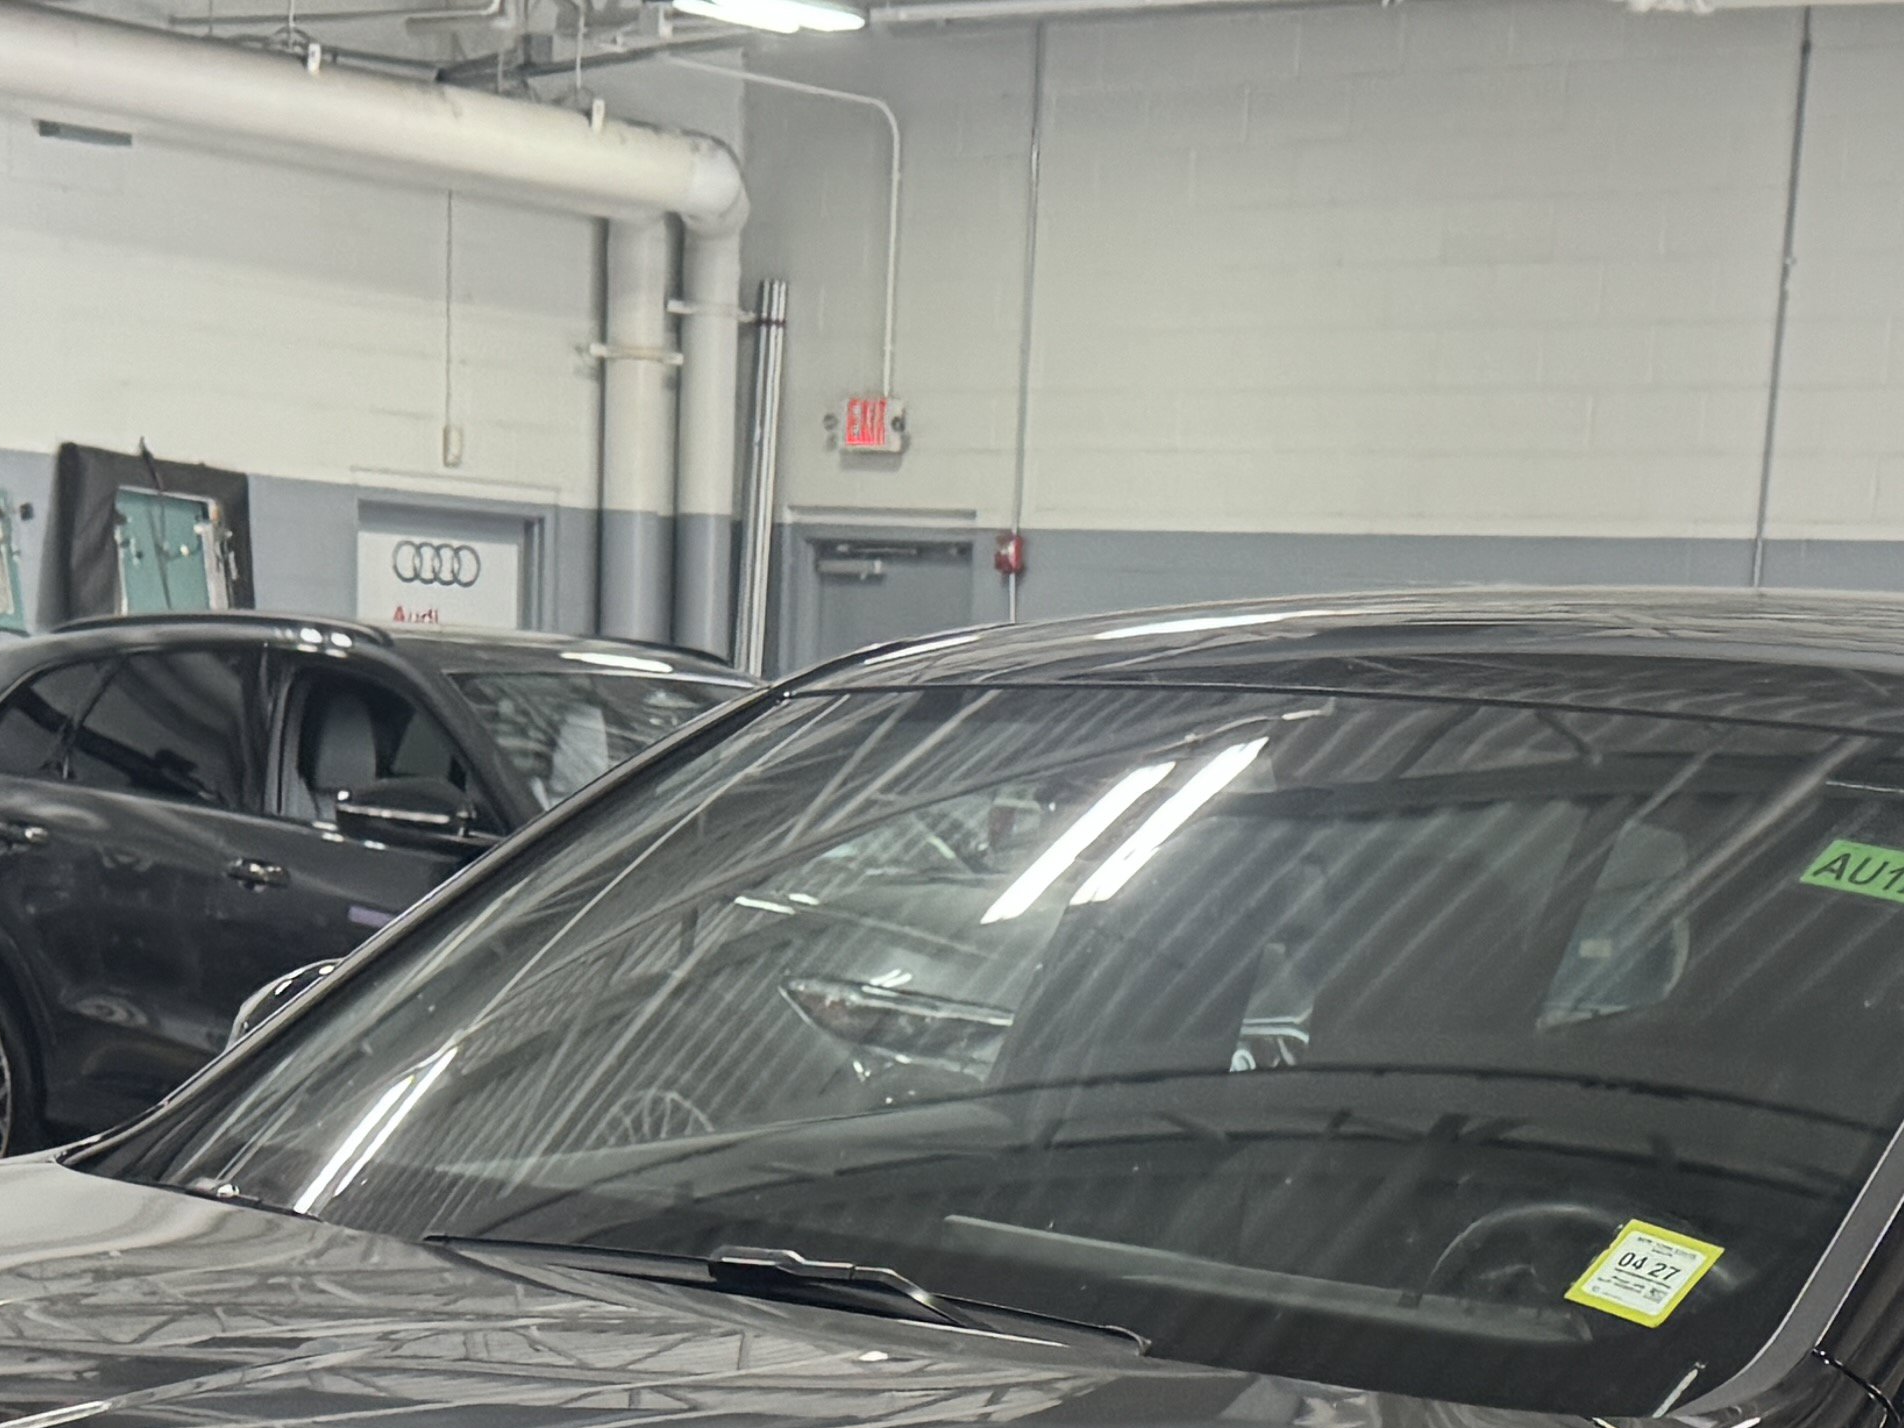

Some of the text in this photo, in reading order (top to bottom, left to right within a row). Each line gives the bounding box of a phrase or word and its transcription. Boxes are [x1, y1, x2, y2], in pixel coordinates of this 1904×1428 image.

[847, 399, 887, 444] EXIT
[393, 605, 438, 624] Audi
[1618, 1252, 1681, 1280] 04 27
